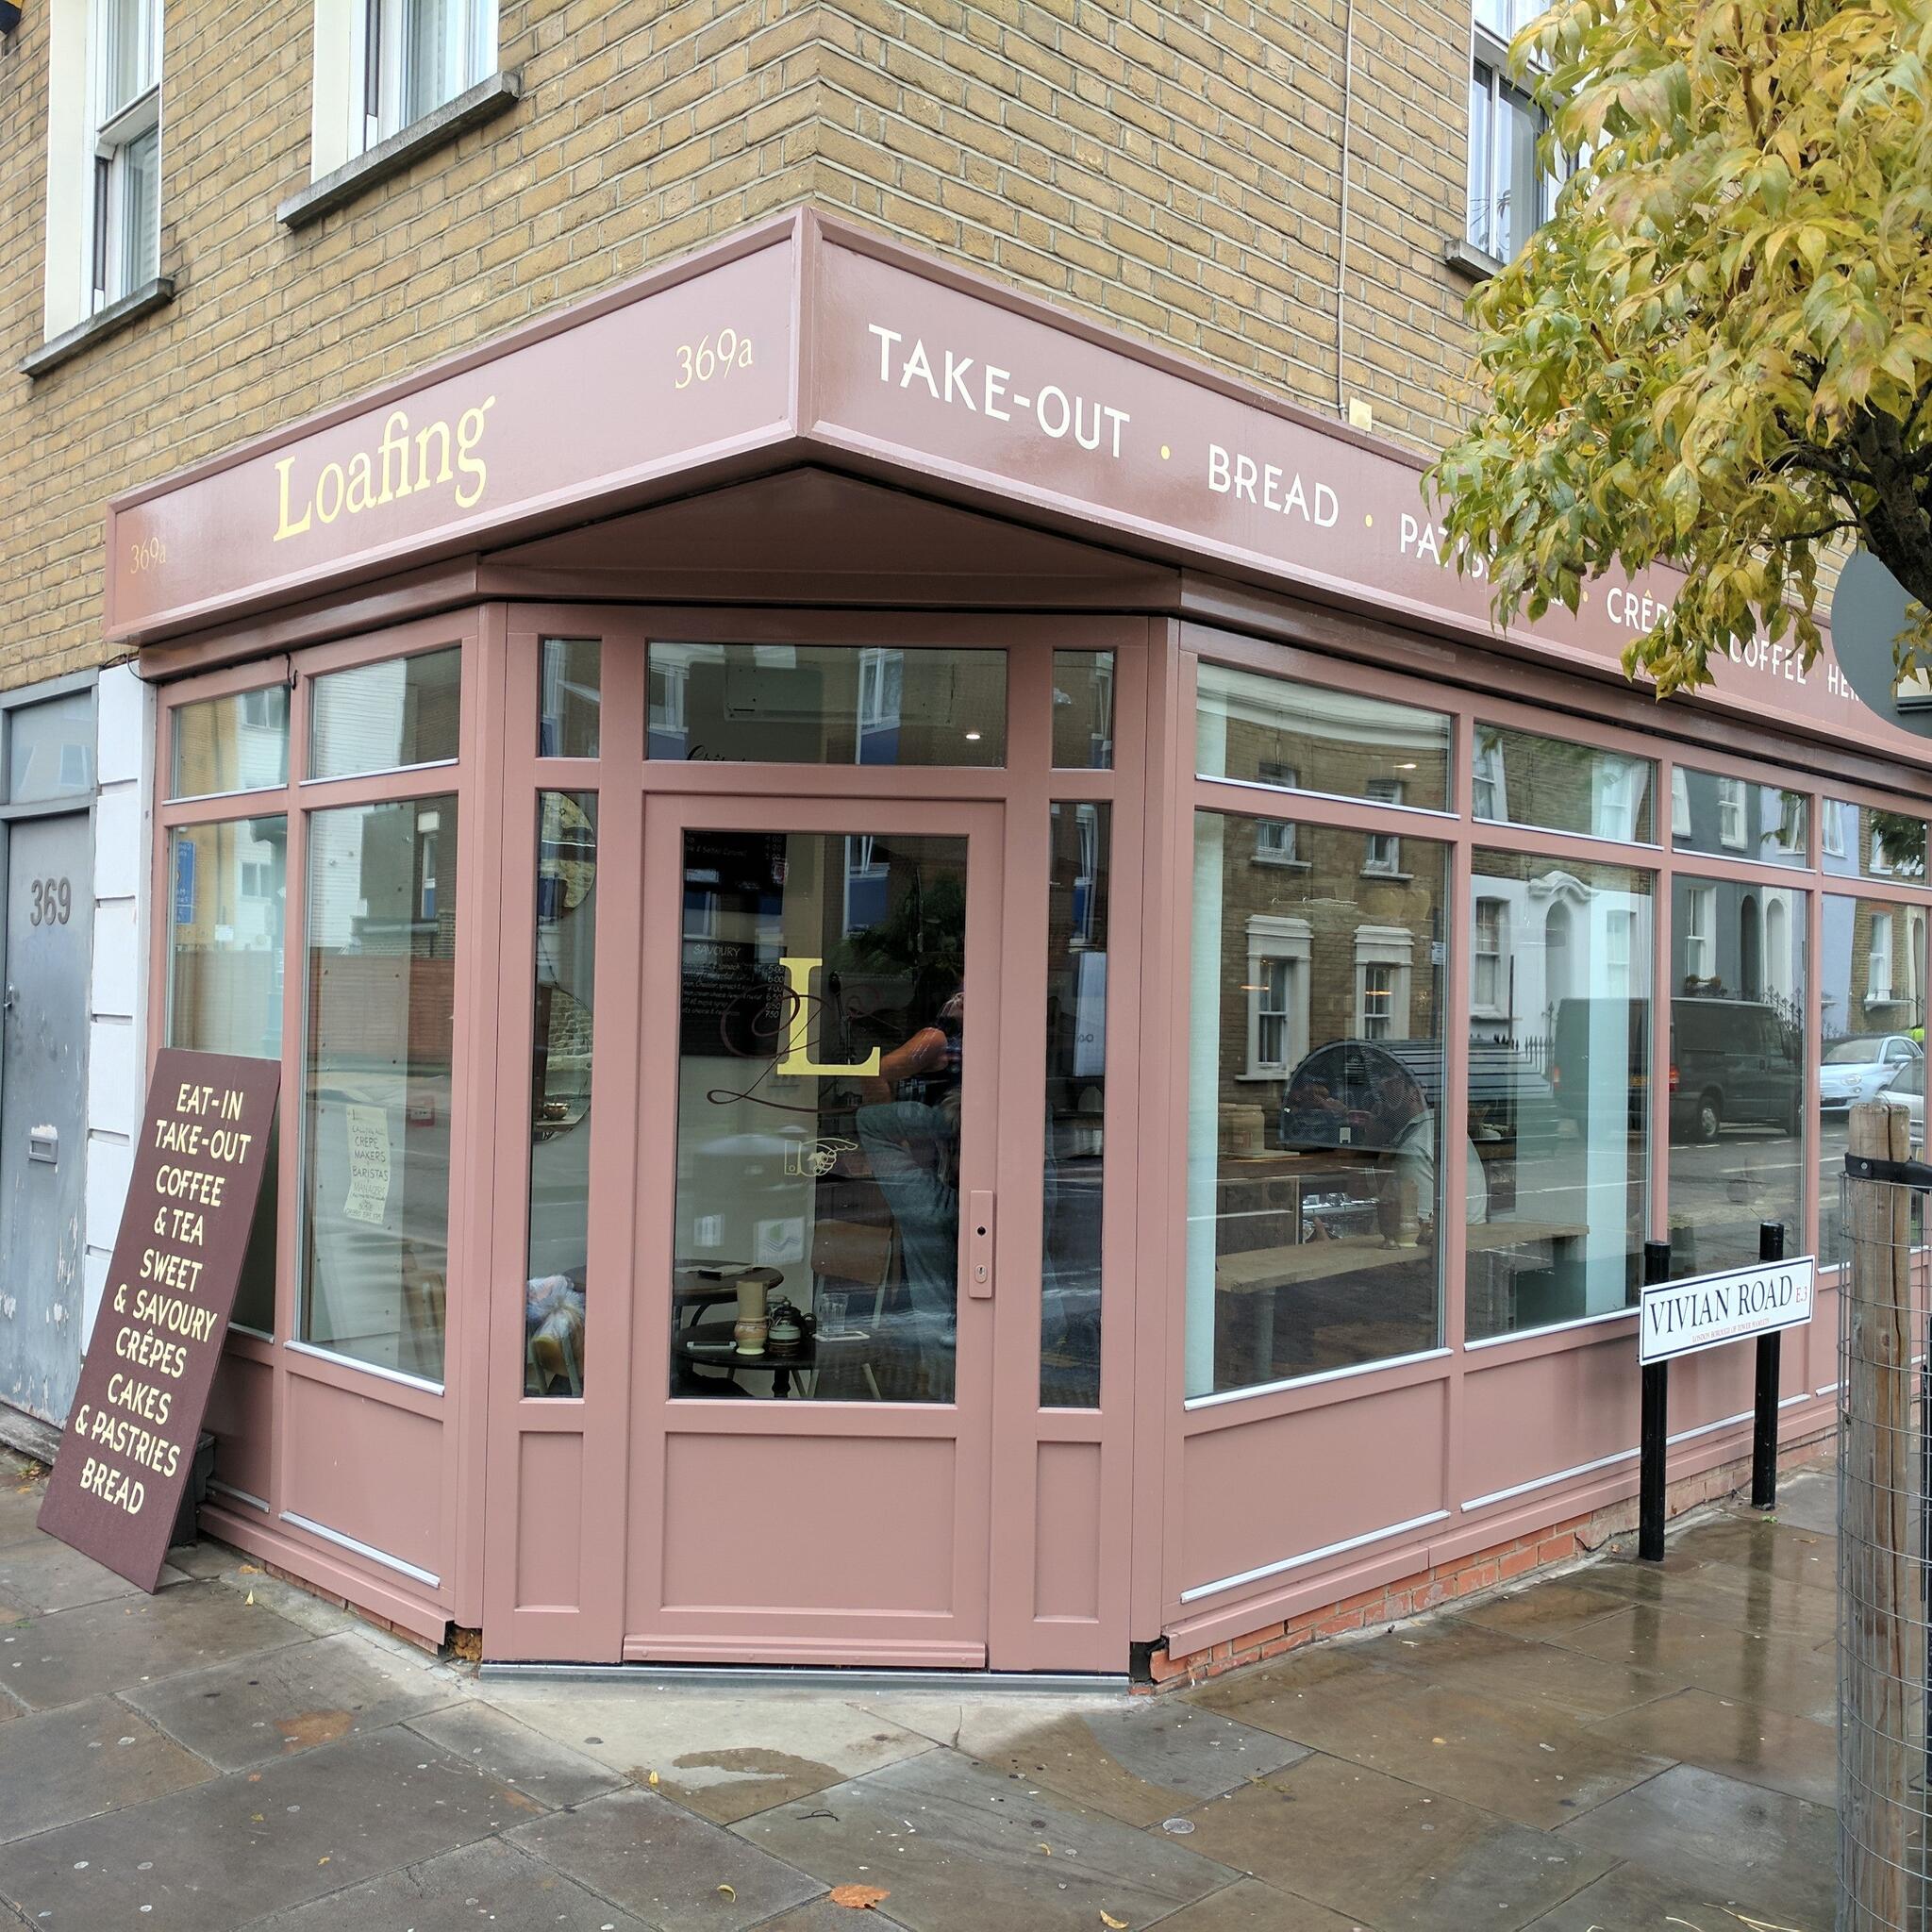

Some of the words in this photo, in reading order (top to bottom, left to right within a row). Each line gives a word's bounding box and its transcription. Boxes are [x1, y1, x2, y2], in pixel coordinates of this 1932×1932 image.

[675, 327, 753, 389] 369a
[868, 323, 1130, 458] TAKE-OUT
[1208, 443, 1339, 528] BREAD
[273, 394, 496, 542] Loafing
[130, 537, 166, 574] 369a
[30, 876, 71, 926] 369
[693, 943, 741, 957] SAVOURY
[777, 958, 881, 1076] L
[176, 1083, 243, 1121] EAT-IN
[156, 1119, 252, 1164] TAKE-OUT
[354, 1150, 386, 1163] MAKERS
[156, 1164, 225, 1208] COFFEE
[352, 1165, 389, 1182] BARISTAS
[154, 1206, 168, 1236] &
[171, 1208, 204, 1246] TEA
[140, 1248, 203, 1293] SWEET
[113, 1283, 127, 1314] &
[132, 1289, 218, 1343] SAVOURY
[1650, 1287, 1731, 1337] VIVIAN
[1738, 1274, 1792, 1316] ROAD
[115, 1326, 188, 1378] CRÊPES
[108, 1373, 172, 1425] CAKES
[75, 1404, 91, 1436] &
[91, 1411, 181, 1477] PASTRIES
[80, 1457, 145, 1515] BREAD
